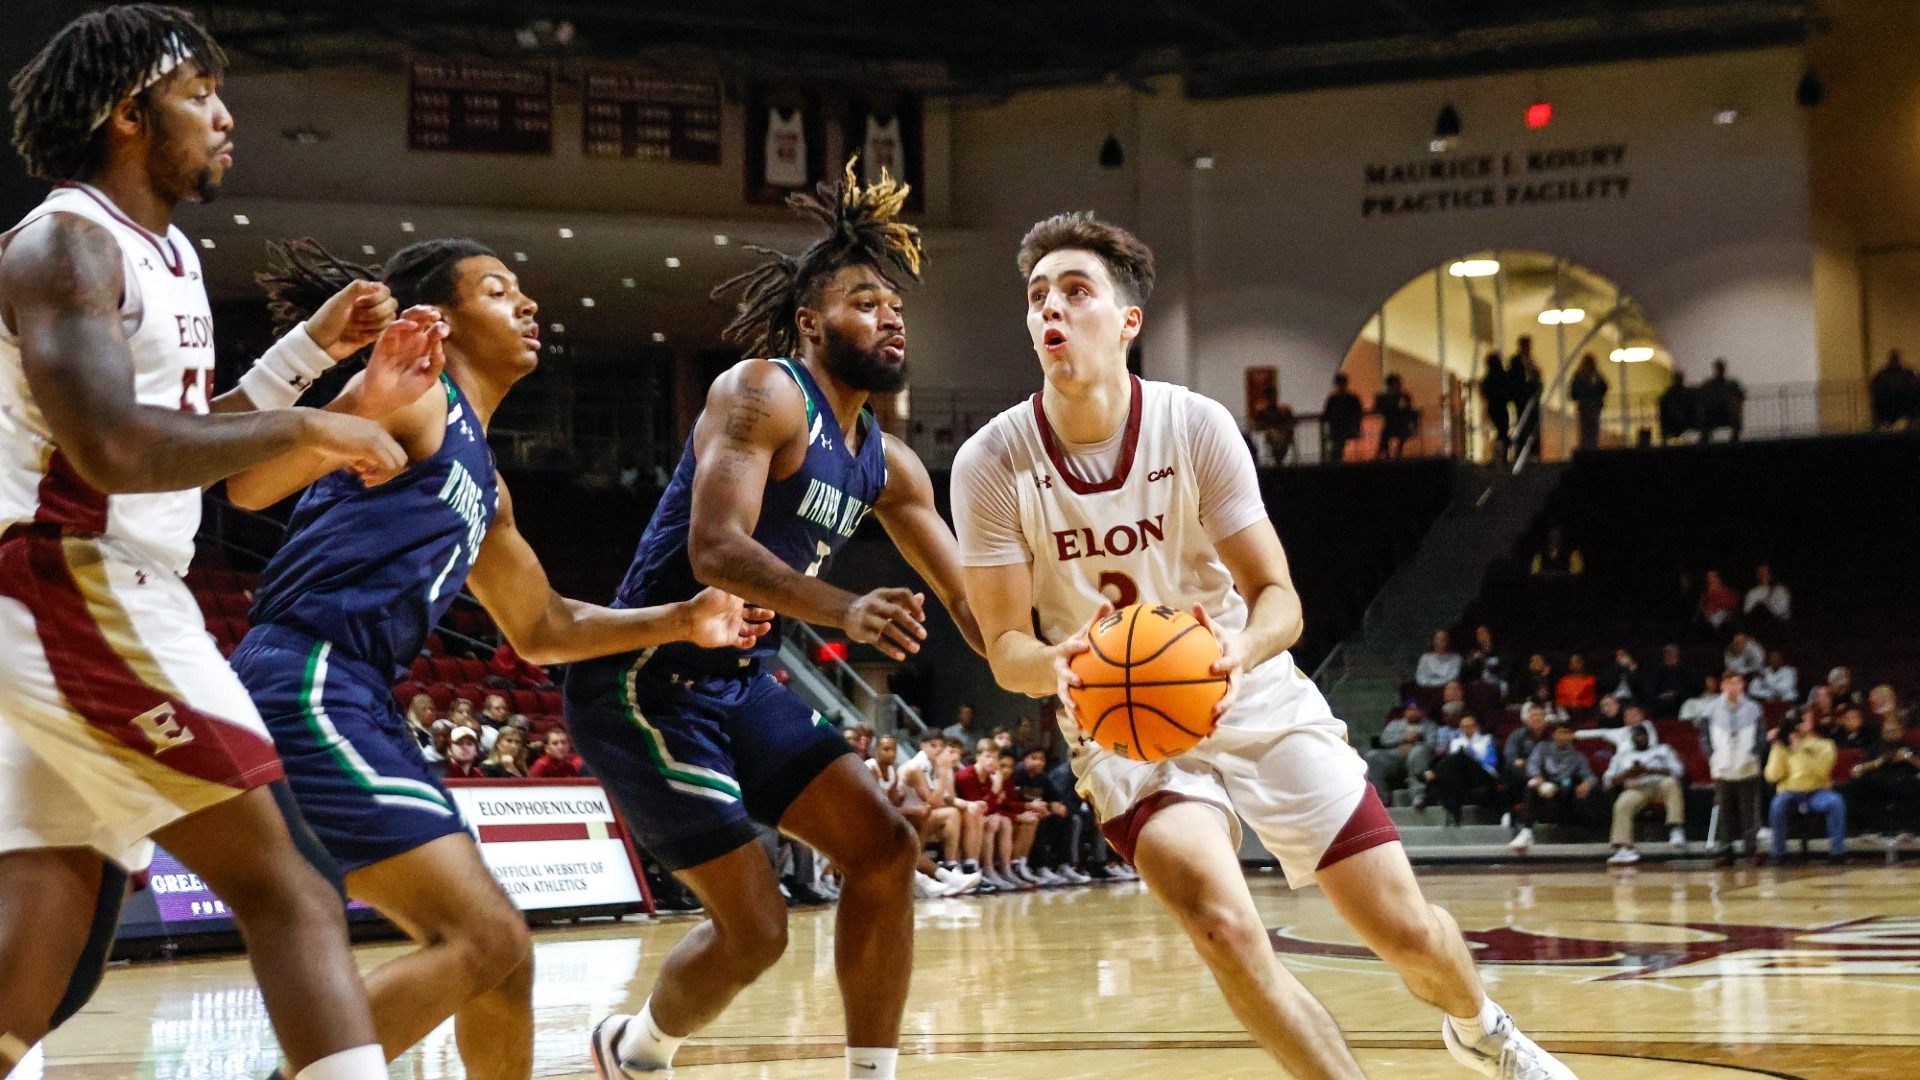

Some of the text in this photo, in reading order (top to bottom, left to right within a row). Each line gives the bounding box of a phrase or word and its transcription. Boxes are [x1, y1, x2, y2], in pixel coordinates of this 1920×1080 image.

[1364, 153, 1493, 185] MAURICE
[1361, 175, 1630, 217] PRACTICE FACILITY
[1148, 466, 1175, 482] CAA
[1052, 514, 1164, 561] ELON
[479, 800, 607, 817] ELONPHOENIX.COM
[496, 862, 604, 879] OFFICIAL WEBSITE OF
[150, 873, 208, 895] GREE
[534, 878, 588, 893] ATHLETICS
[191, 900, 228, 916] FUR
